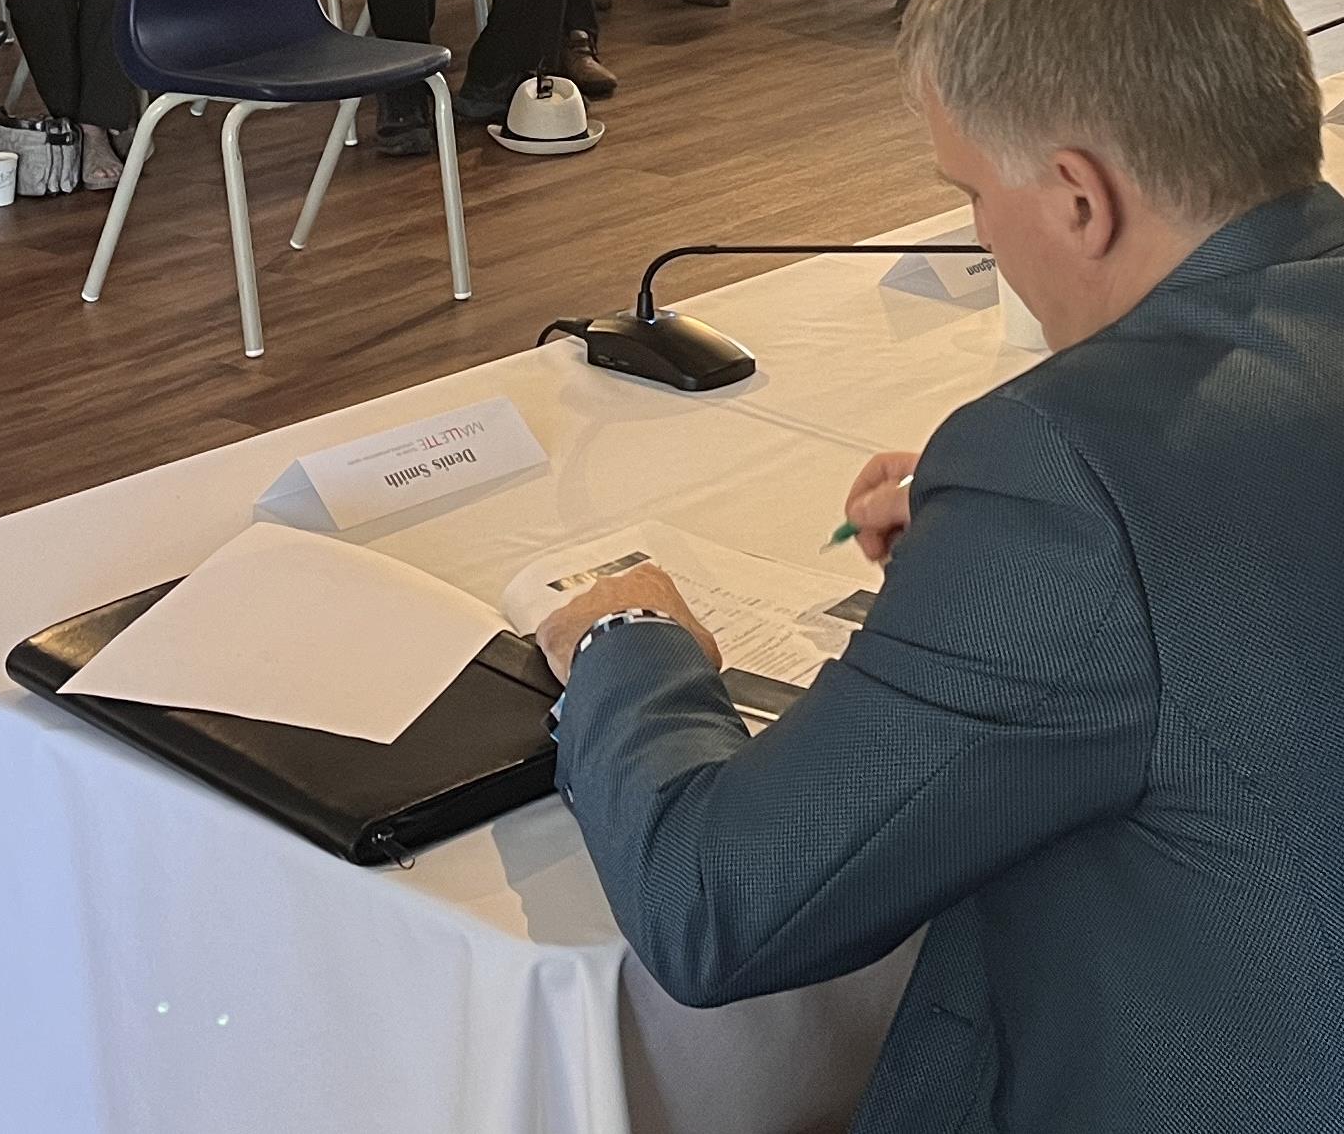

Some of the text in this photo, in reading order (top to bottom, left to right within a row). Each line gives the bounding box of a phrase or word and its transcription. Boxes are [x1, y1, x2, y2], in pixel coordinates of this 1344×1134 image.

[419, 420, 485, 451] MALLETTE
[433, 448, 477, 473] Denis
[384, 463, 431, 489] Smith
